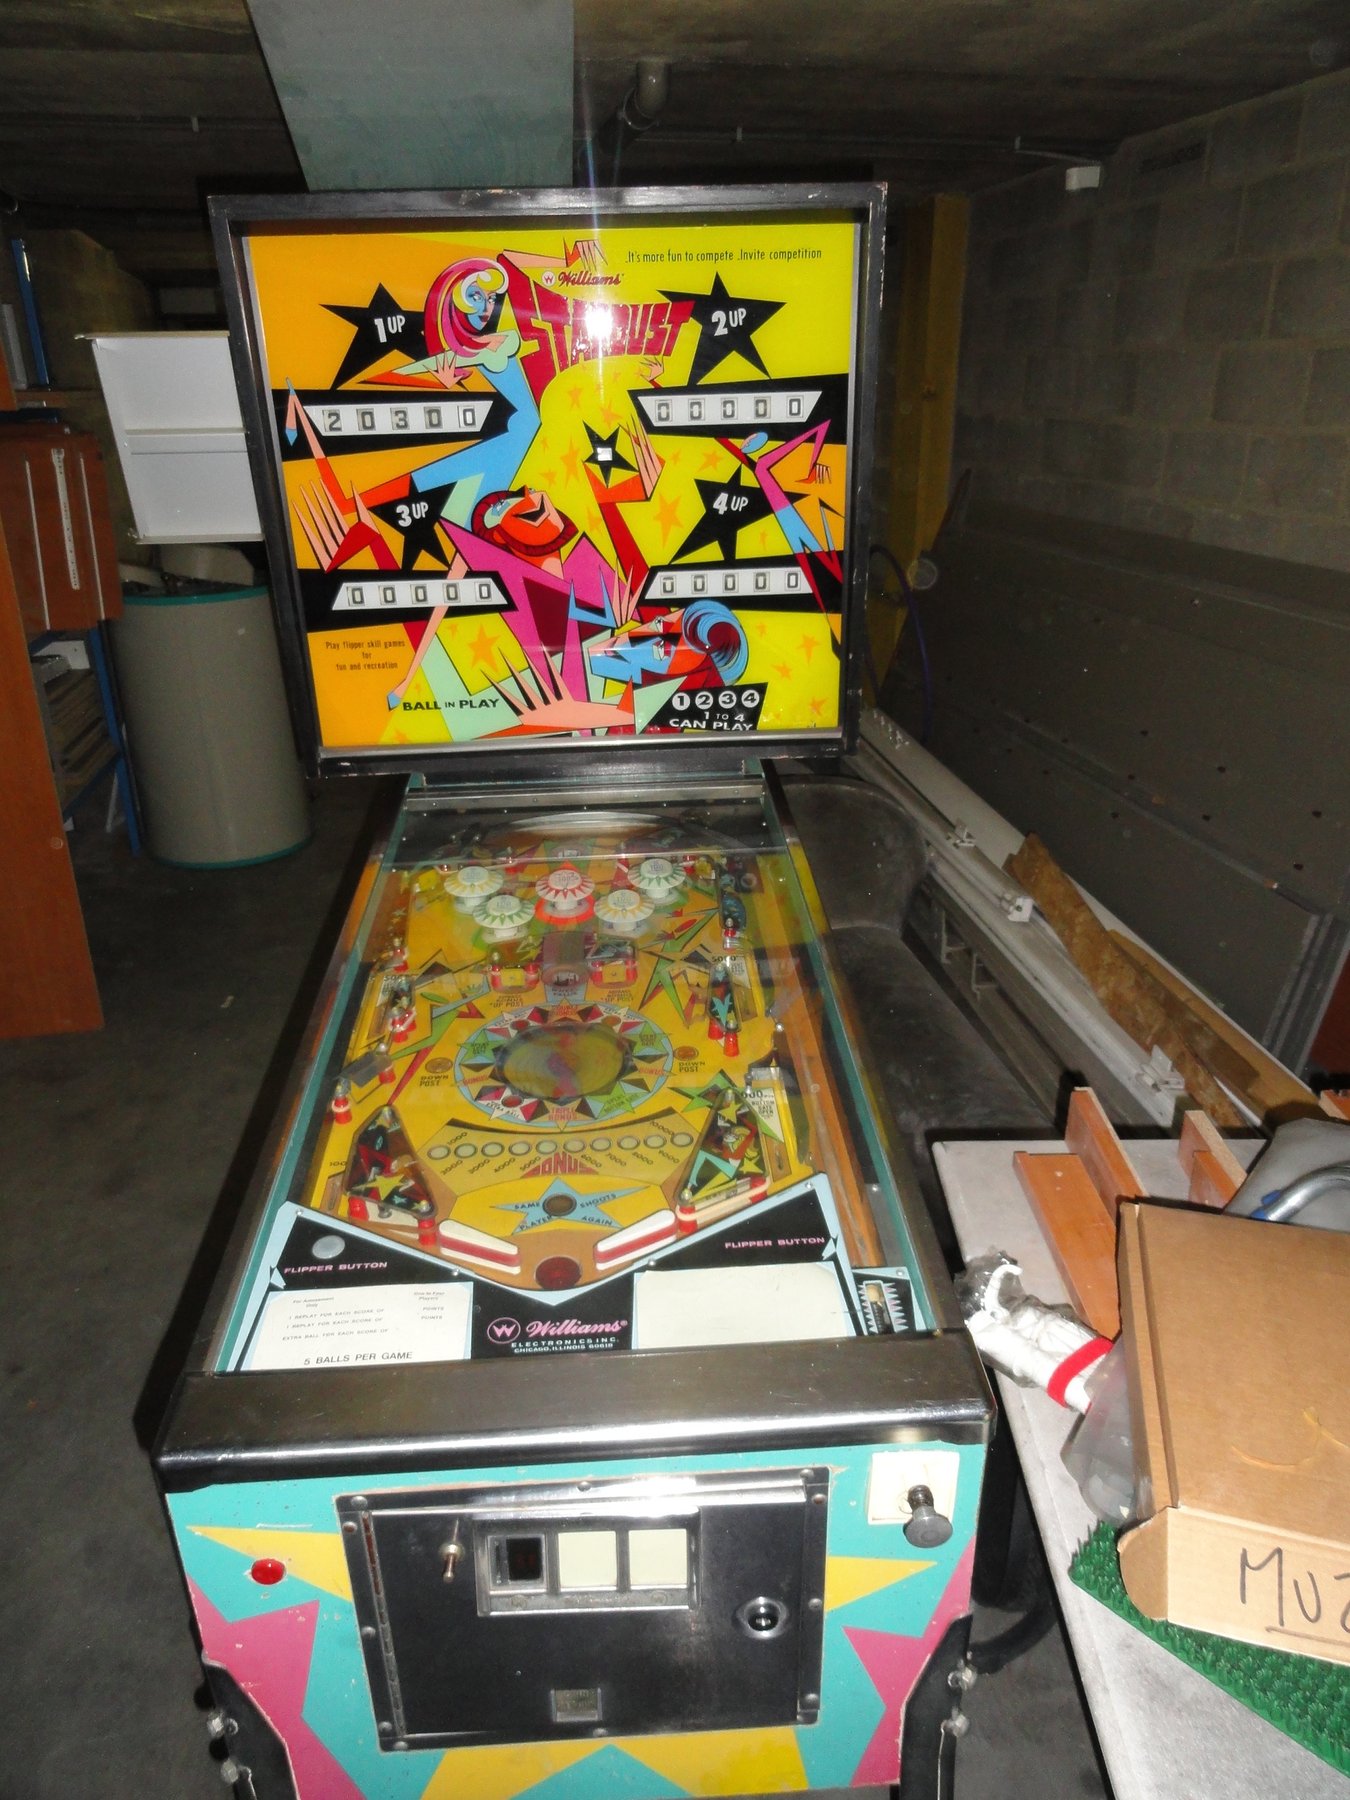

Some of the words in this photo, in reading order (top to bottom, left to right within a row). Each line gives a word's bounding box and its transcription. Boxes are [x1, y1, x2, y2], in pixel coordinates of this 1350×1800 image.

[643, 251, 664, 262] more
[668, 249, 682, 262] fun
[685, 250, 693, 262] to
[697, 250, 733, 264] compete
[769, 248, 822, 262] competition
[558, 271, 621, 287] Williams
[498, 254, 696, 405] STADUST
[384, 640, 406, 648] games
[403, 700, 441, 711] BALL
[459, 698, 499, 710] PLAY
[734, 711, 744, 722] 4
[669, 718, 705, 728] CAN
[713, 721, 752, 732] PLAY
[580, 1193, 617, 1208] SHOOTS
[582, 1215, 612, 1226] AGAIN
[725, 1238, 772, 1249] FLIPPER
[777, 1236, 825, 1247] BUTTON
[284, 1264, 334, 1274] FLIPPER
[338, 1261, 388, 1271] BUTTON
[525, 1318, 622, 1338] Williams
[511, 1338, 593, 1349] ELECTRONICS
[303, 1357, 311, 1366] 5
[315, 1354, 350, 1365] BALLS
[355, 1352, 376, 1361] PER
[381, 1351, 413, 1360] GAME
